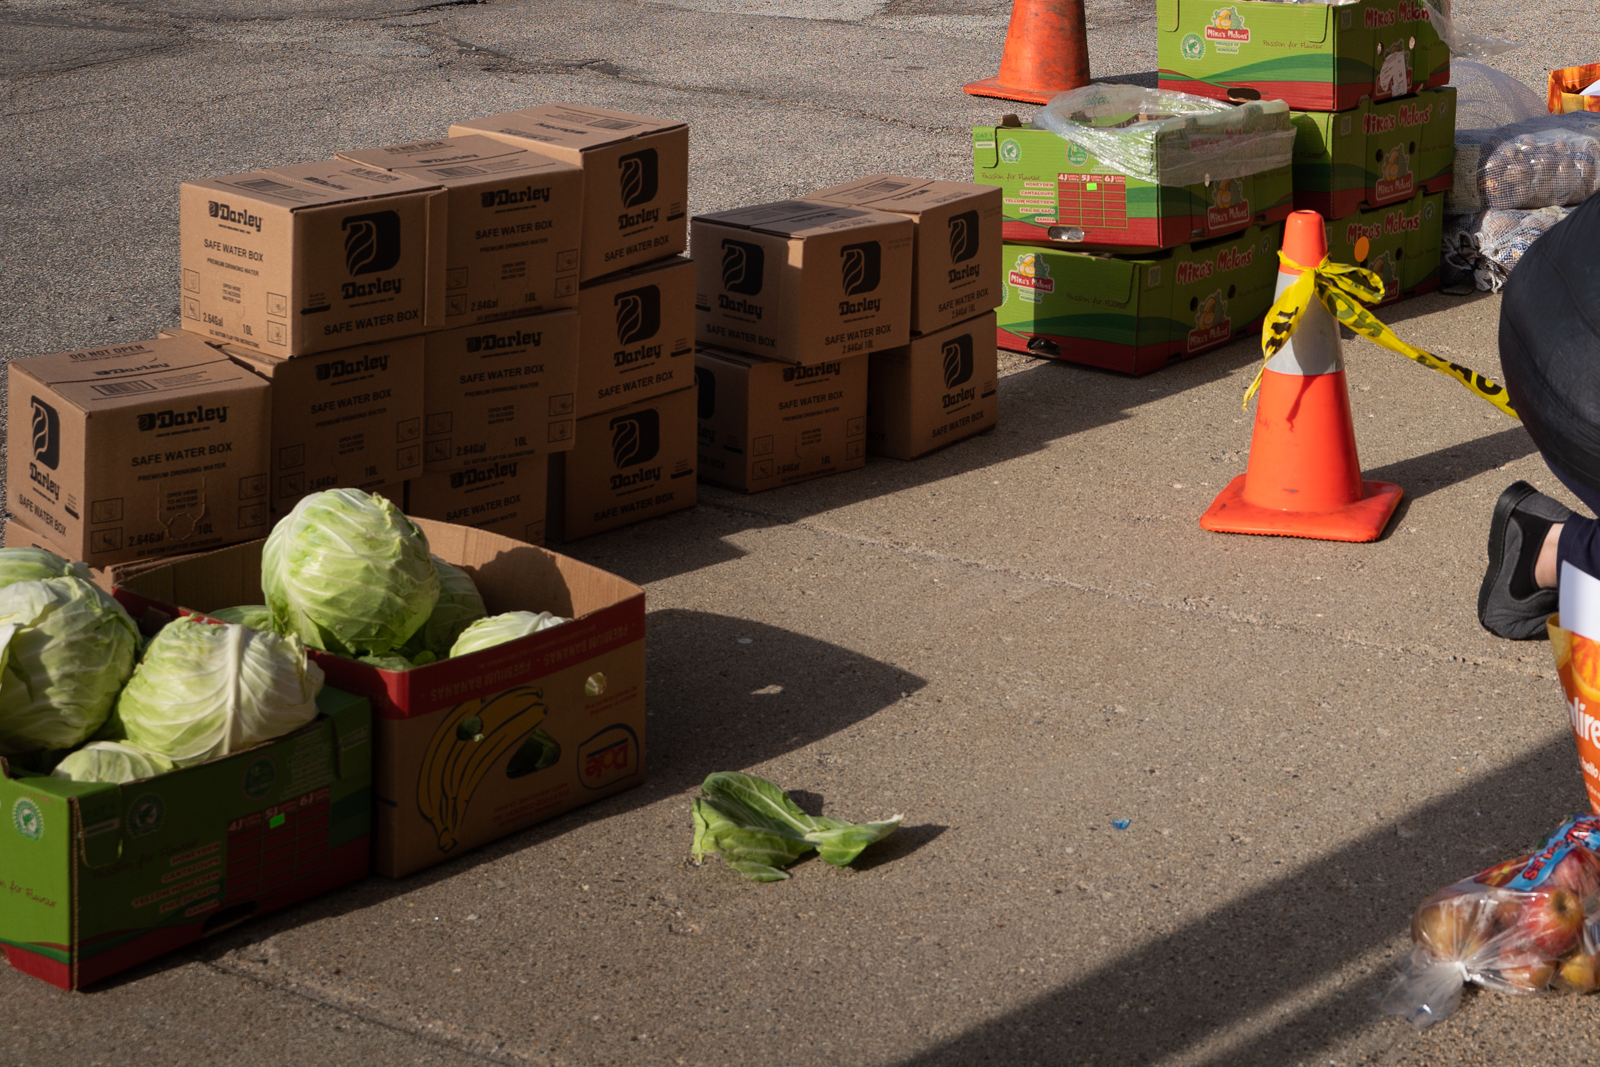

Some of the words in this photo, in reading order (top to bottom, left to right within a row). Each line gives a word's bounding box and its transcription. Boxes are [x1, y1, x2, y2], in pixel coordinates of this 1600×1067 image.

[1364, 7, 1395, 28] Mike's
[1208, 29, 1225, 38] Mike's
[1228, 31, 1247, 39] Melons
[1263, 40, 1285, 48] Passion
[1288, 41, 1297, 49] for
[1363, 113, 1395, 135] Mike's
[1399, 104, 1431, 127] Melons
[497, 186, 550, 206] Darley
[220, 207, 262, 232] Darley
[475, 229, 499, 240] SAFE
[501, 224, 533, 236] WATER
[535, 220, 553, 231] BOX
[618, 208, 659, 230] Darley
[1348, 223, 1380, 244] Mike's
[1384, 211, 1421, 233] Melons
[204, 238, 221, 252] SAFE
[223, 244, 247, 258] WATER
[249, 249, 263, 262] BOX
[605, 249, 624, 262] SAFE
[626, 240, 652, 255] WATER
[654, 235, 669, 247] BOX
[948, 264, 980, 283] Darley
[1177, 259, 1213, 284] Mike's
[1217, 247, 1253, 272] Melons
[341, 277, 401, 300] Darley
[525, 292, 536, 303] 10L
[938, 300, 952, 313] SAFE
[954, 293, 975, 309] WATER
[976, 287, 988, 299] BOX
[718, 294, 762, 320] Darley
[839, 298, 881, 316] Darley
[1066, 292, 1089, 304] Passion
[1092, 296, 1103, 306] for
[1104, 299, 1128, 310] Flavour
[243, 324, 253, 336] 10L
[324, 324, 352, 336] SAFE
[355, 316, 395, 331] WATER
[397, 309, 419, 322] BOX
[482, 331, 542, 351] Darley
[706, 323, 726, 336] SAFE
[727, 327, 756, 343] WATER
[758, 334, 776, 347] BOX
[825, 335, 845, 345] SAFE
[847, 329, 873, 343] WATER
[875, 324, 891, 335] BOX
[865, 339, 874, 349] 10L
[90, 349, 113, 358] NOT
[115, 345, 145, 355] OPEN
[614, 344, 662, 367] Darley
[332, 355, 388, 378] Darley
[460, 372, 485, 384] SAFE
[488, 367, 522, 381] WATER
[524, 364, 544, 376] BOX
[796, 362, 840, 379] Darley
[598, 385, 621, 399] SAFE
[623, 376, 654, 394] WATER
[656, 370, 673, 384] BOX
[311, 401, 335, 415] SAFE
[338, 393, 370, 409] WATER
[372, 389, 391, 402] BOX
[779, 399, 798, 411] SAFE
[800, 394, 826, 407] WATER
[828, 391, 843, 402] BOX
[942, 387, 975, 409] Darley
[157, 406, 228, 429] Darley
[932, 425, 948, 438] SAFE
[949, 417, 969, 433] WATER
[970, 411, 984, 423] BOX
[132, 454, 162, 467] SAFE
[165, 447, 206, 462] WATER
[209, 442, 232, 455] BOX
[30, 462, 59, 500] Darley
[19, 494, 34, 511] SAFE
[35, 503, 54, 526] WATER
[54, 519, 66, 536] BOX
[589, 629, 628, 648] PREMIUM
[545, 643, 587, 666] BANANAS
[485, 661, 531, 685] PREMIUM
[431, 677, 482, 701] BANANAS
[585, 744, 628, 778] Dole
[164, 858, 220, 881] CANTALOUPE
